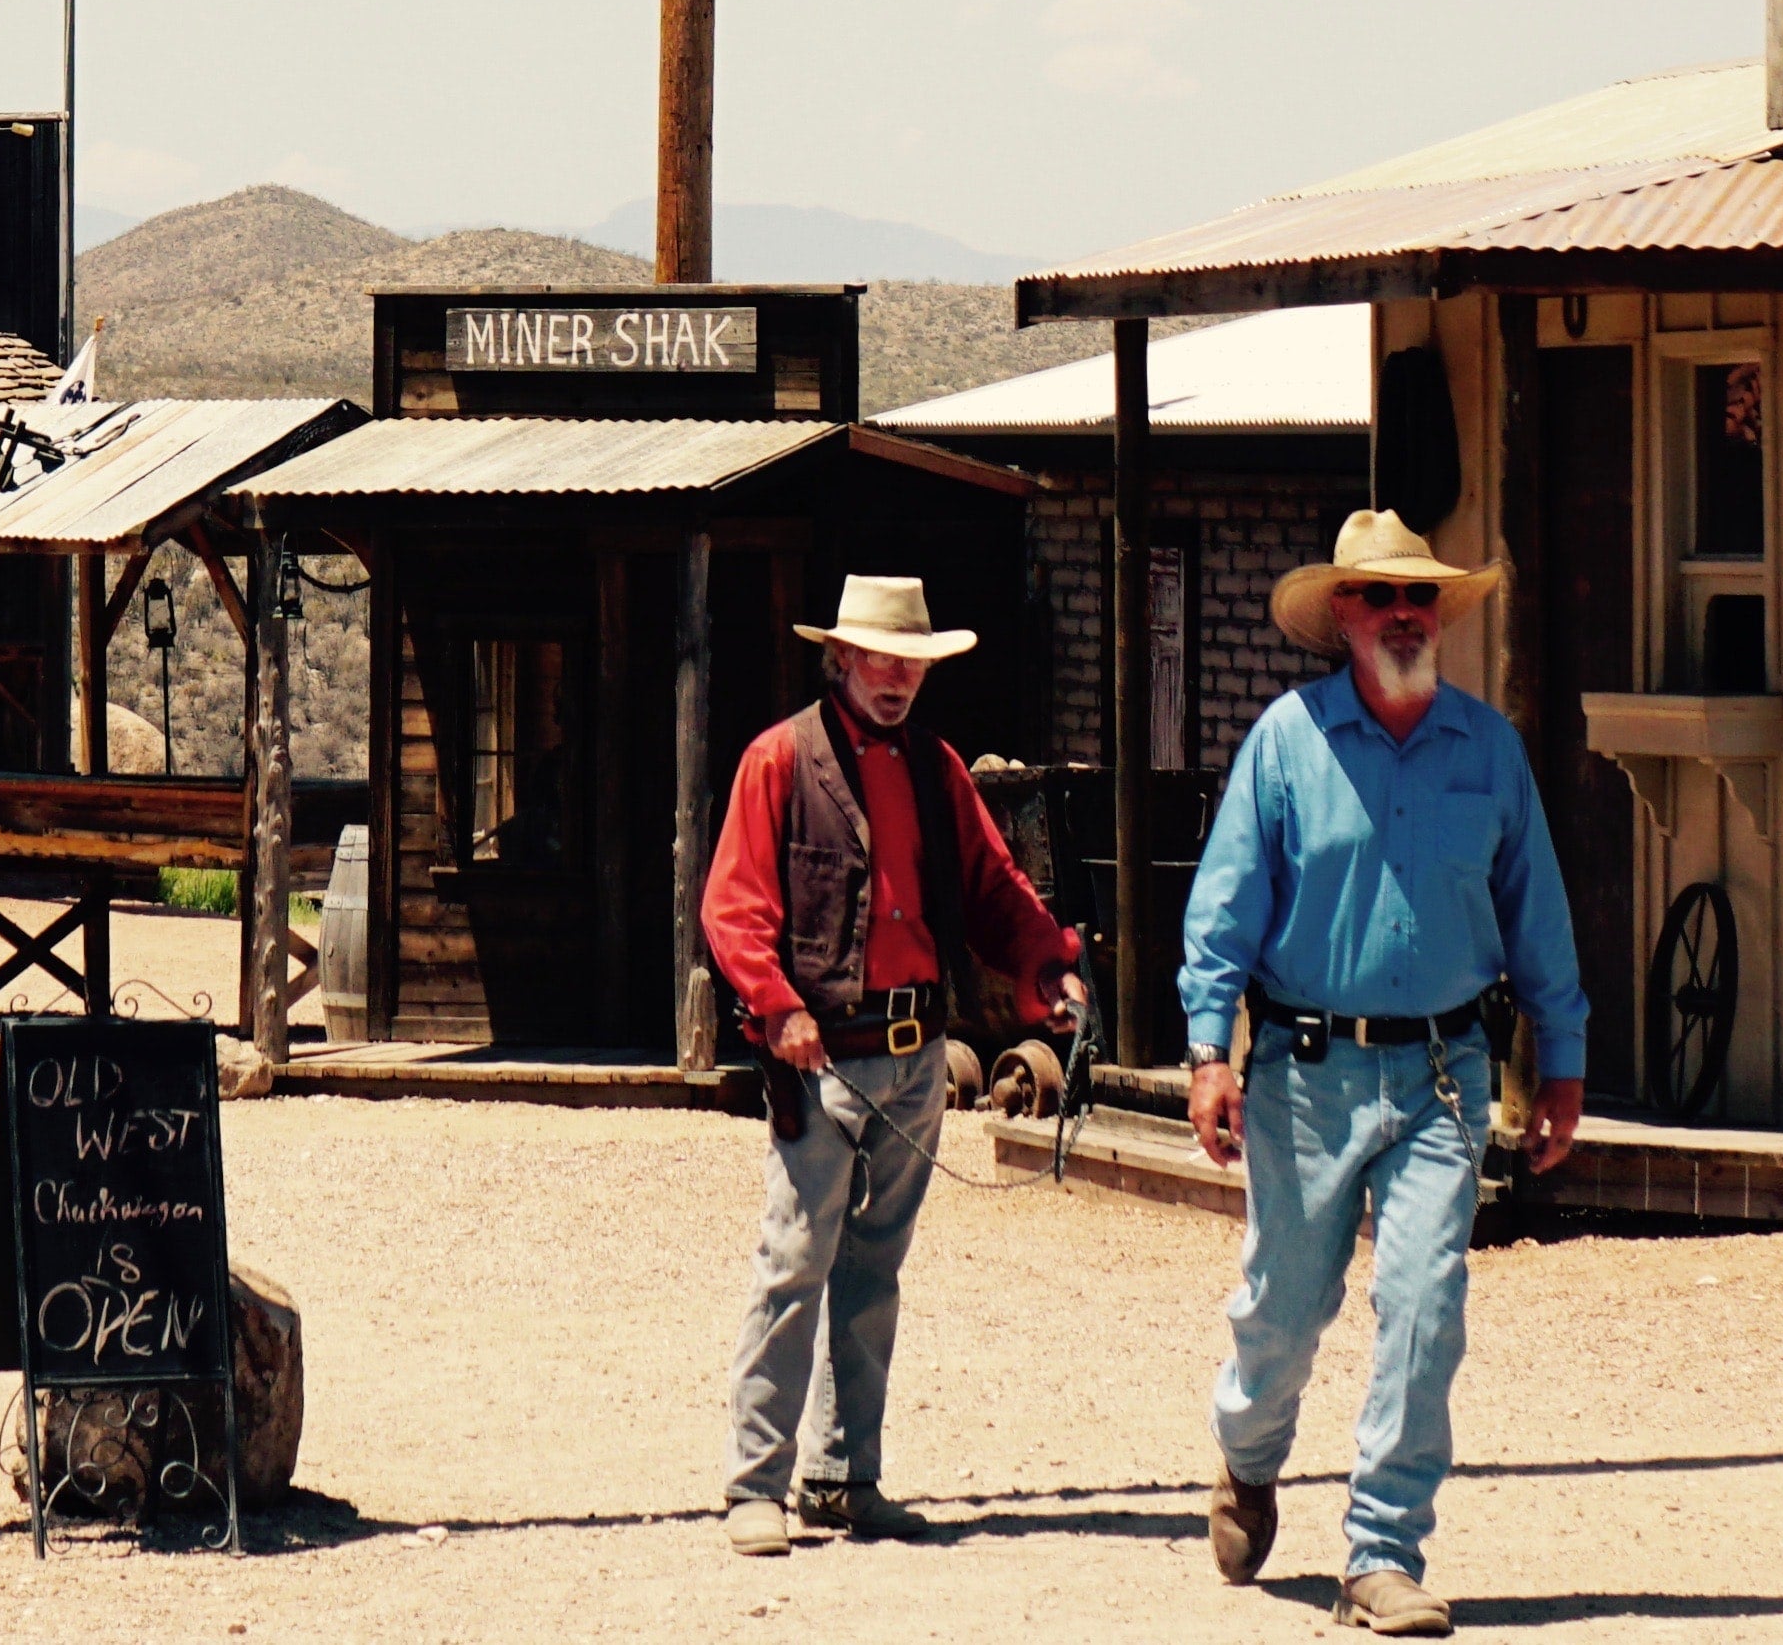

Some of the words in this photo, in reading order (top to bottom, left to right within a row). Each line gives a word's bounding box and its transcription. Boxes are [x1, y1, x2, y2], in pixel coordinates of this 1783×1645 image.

[466, 313, 593, 365] MINER
[611, 313, 732, 366] SHAK
[29, 1058, 122, 1107] OLD
[77, 1109, 199, 1160] WEST
[38, 1276, 203, 1365] OPEN
